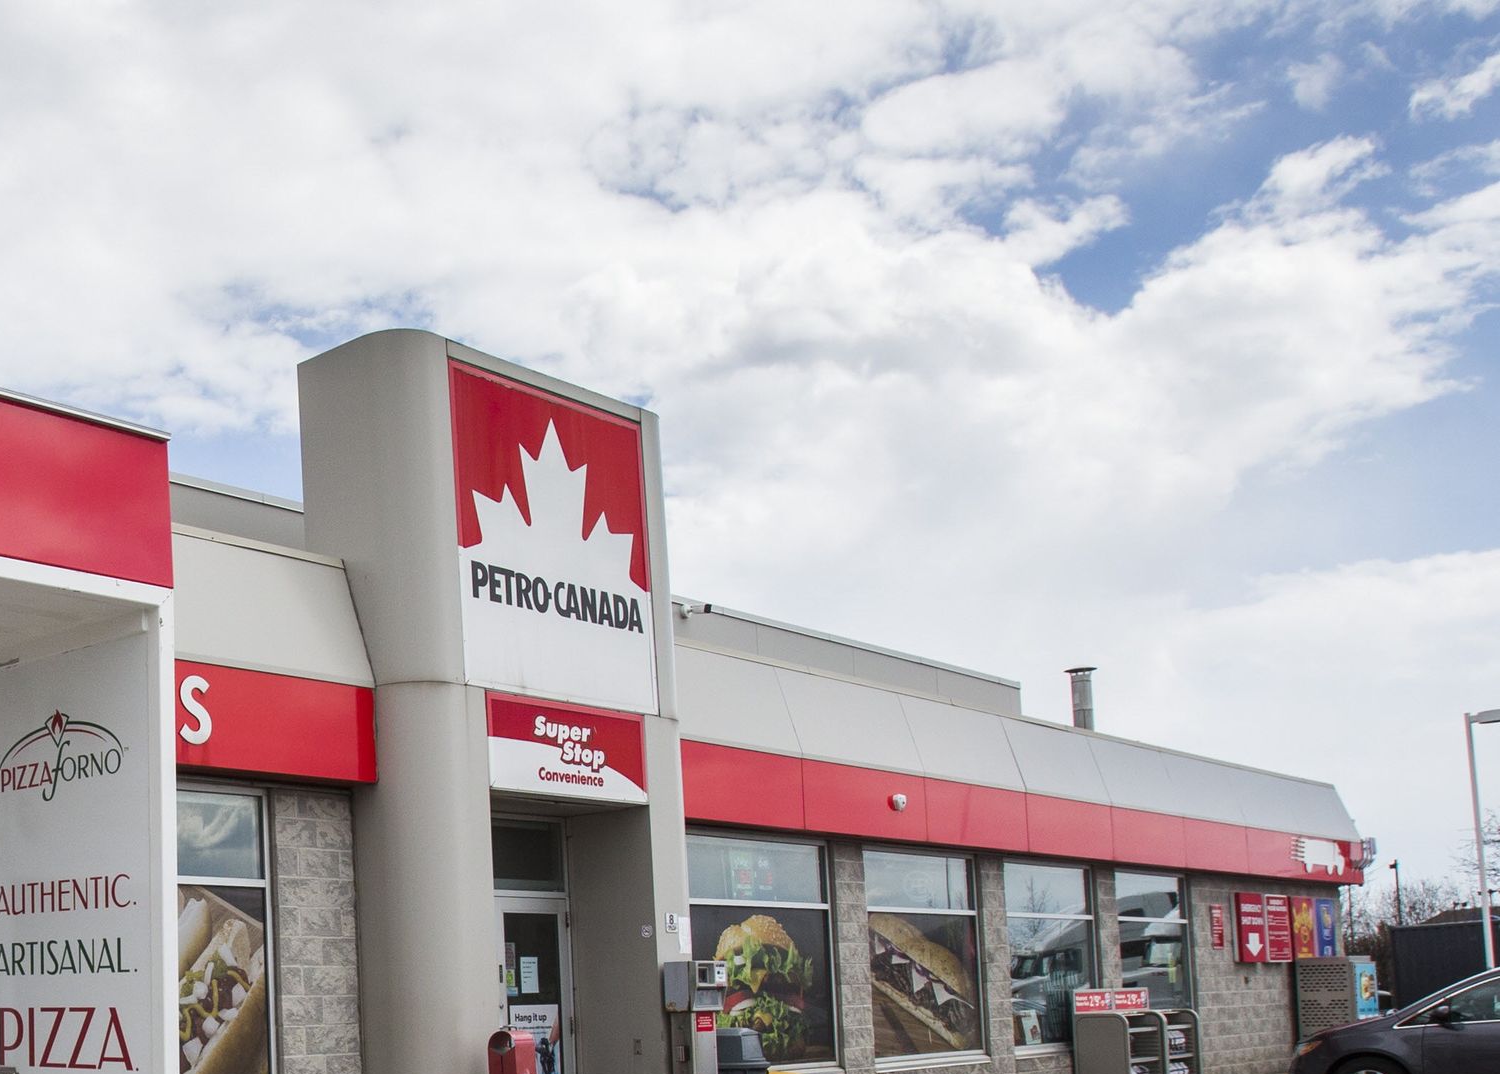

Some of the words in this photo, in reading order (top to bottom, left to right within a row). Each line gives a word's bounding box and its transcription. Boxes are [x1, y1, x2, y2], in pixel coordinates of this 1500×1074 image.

[534, 715, 591, 744] Super
[562, 741, 606, 771] Stop
[538, 767, 604, 787] Convenience
[514, 1013, 532, 1023] Hang
[532, 1012, 538, 1021] it
[538, 1014, 547, 1022] up
